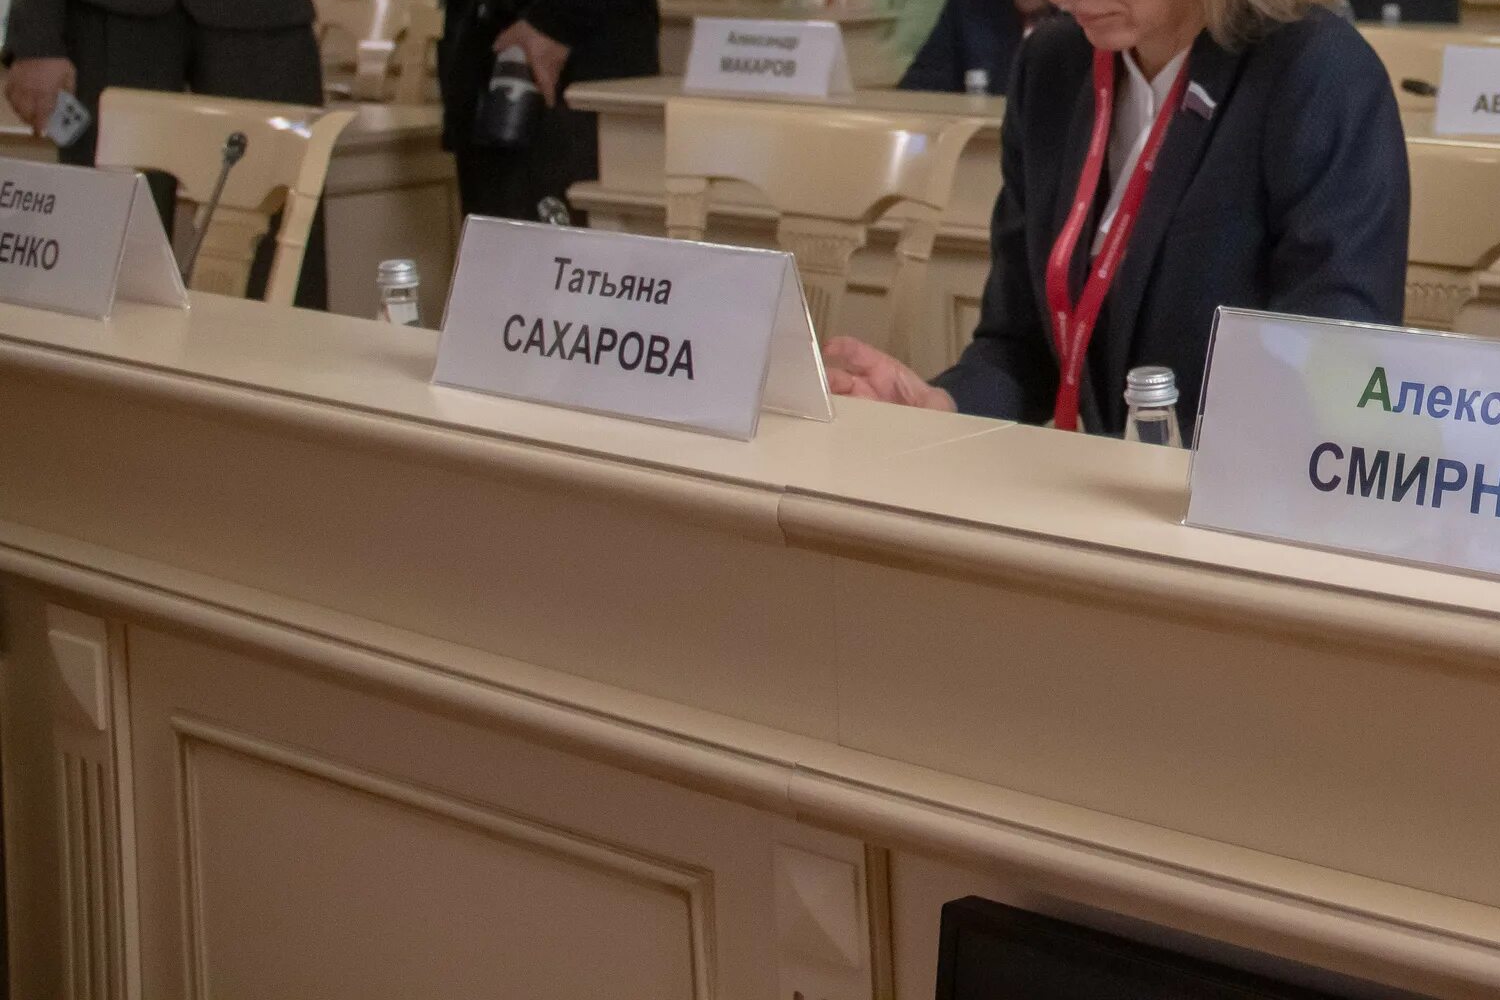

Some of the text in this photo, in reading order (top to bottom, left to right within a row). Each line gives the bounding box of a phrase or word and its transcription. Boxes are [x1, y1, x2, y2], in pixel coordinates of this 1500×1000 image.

[0, 181, 57, 215] Елена
[553, 256, 673, 305] Татьяна
[502, 314, 695, 380] САХАРОВА
